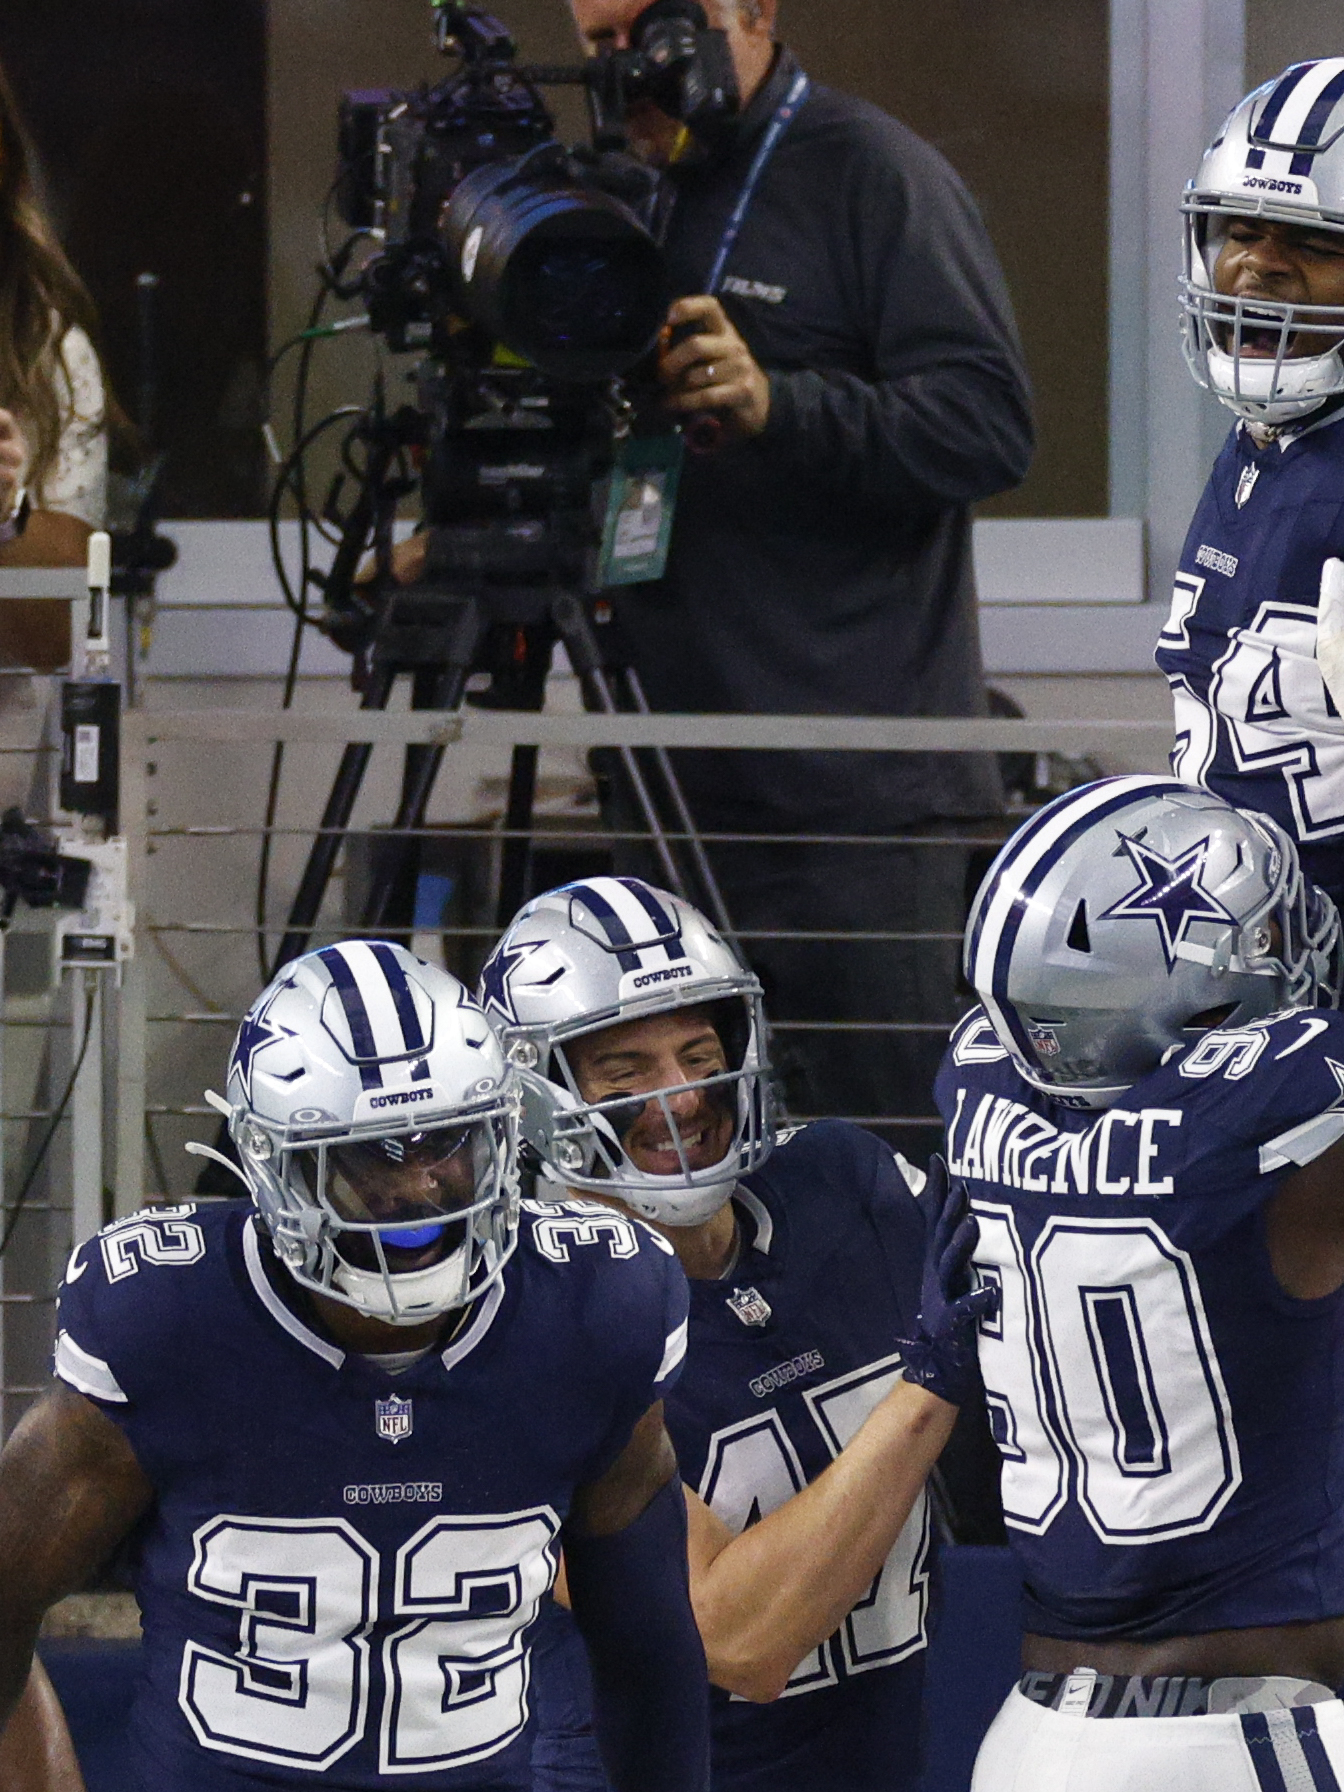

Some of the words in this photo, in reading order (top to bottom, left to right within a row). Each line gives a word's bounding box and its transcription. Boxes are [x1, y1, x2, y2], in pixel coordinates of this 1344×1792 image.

[633, 965, 693, 988] COWBOYS
[370, 1088, 434, 1109] COWBOYS
[949, 1088, 1183, 1196] LAWRENCE
[97, 1202, 207, 1285] 2
[748, 1349, 826, 1398] COWBOYS
[970, 1199, 1243, 1545] 90
[343, 1482, 443, 1505] COWBOYS
[178, 1504, 562, 1775] 32
